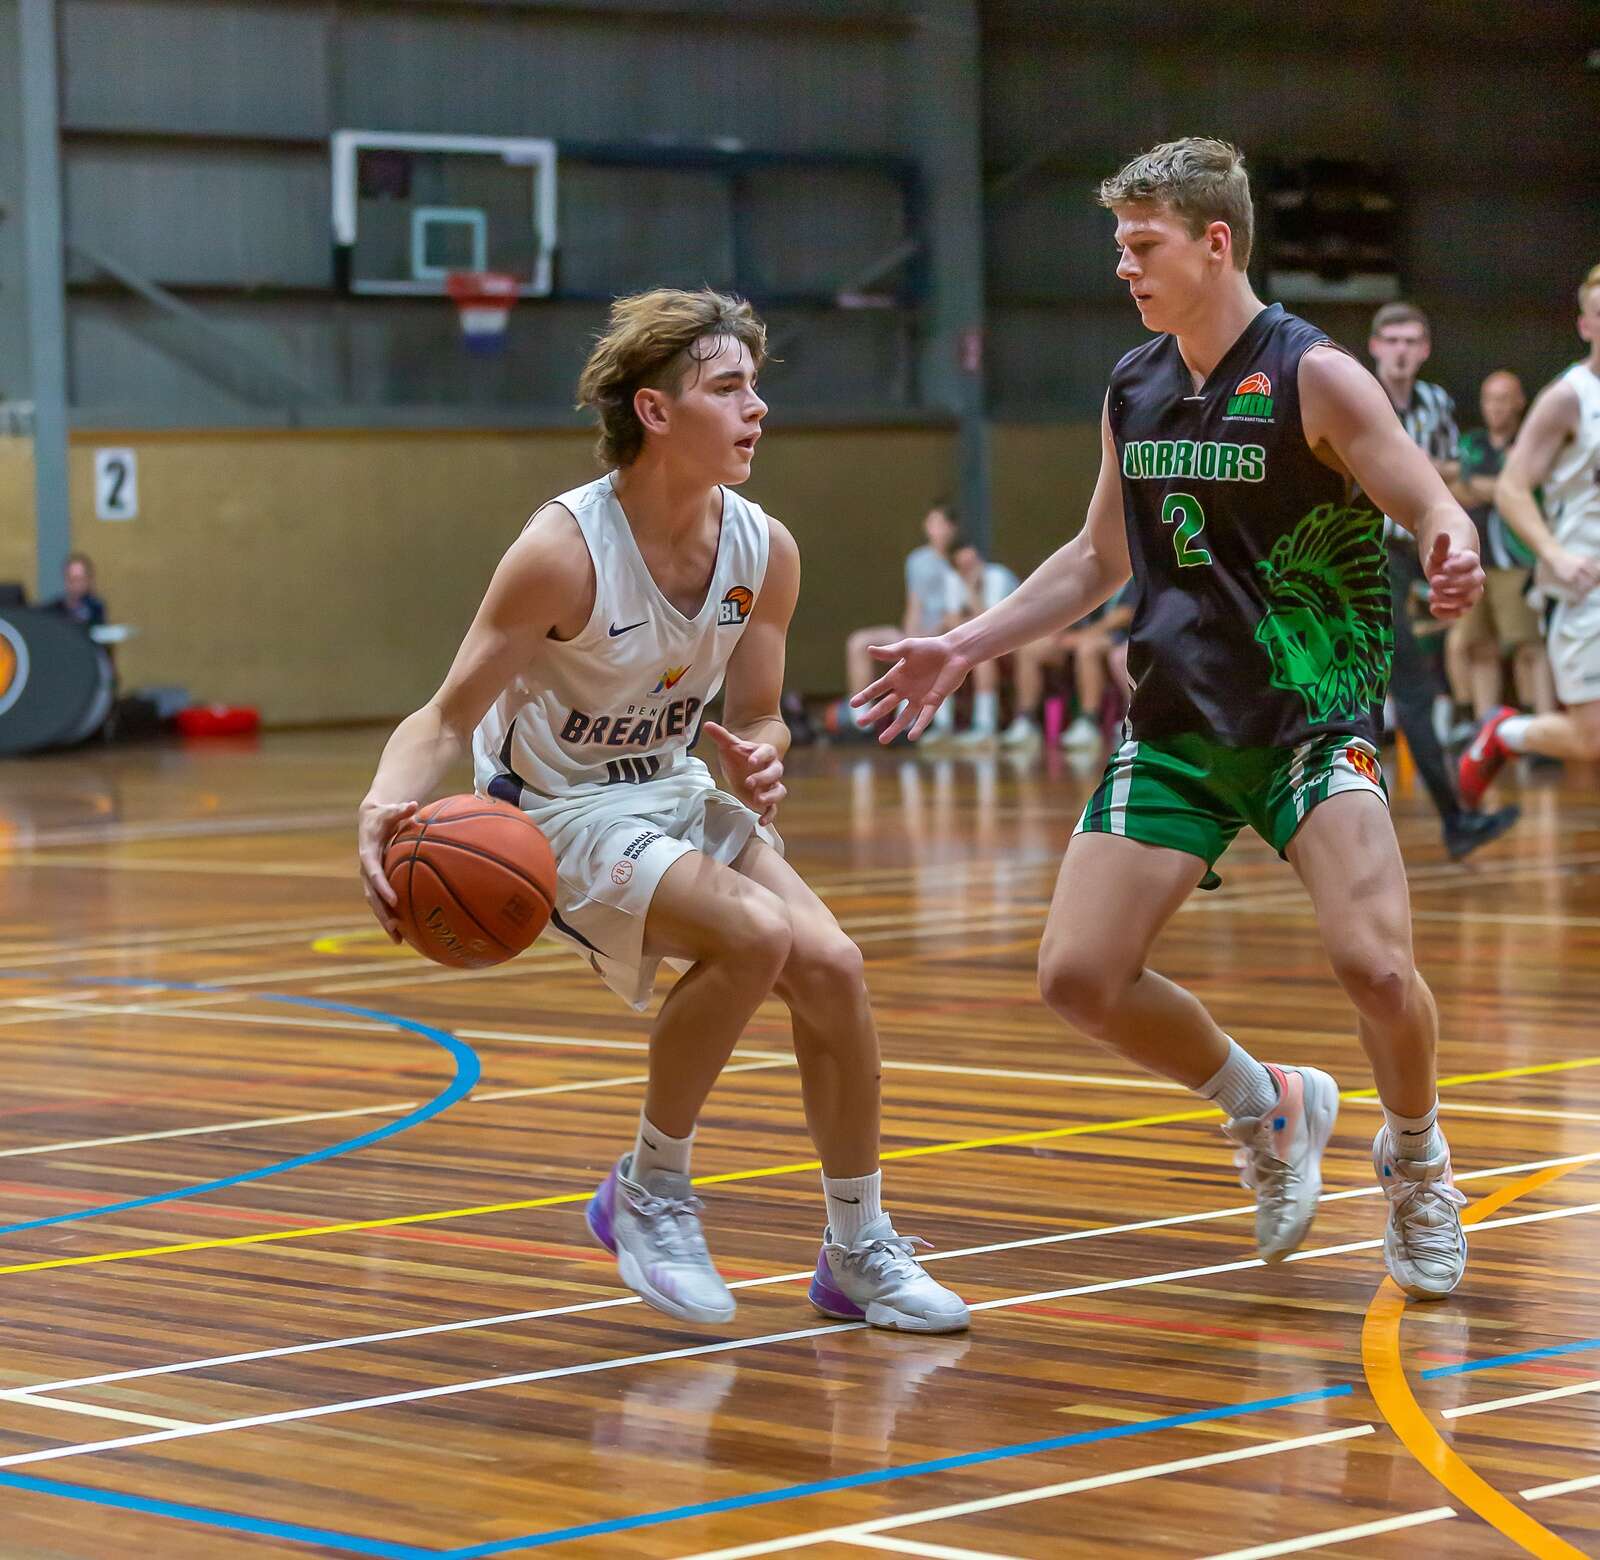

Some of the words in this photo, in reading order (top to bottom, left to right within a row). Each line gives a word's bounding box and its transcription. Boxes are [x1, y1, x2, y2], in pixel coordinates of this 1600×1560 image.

[1123, 439, 1266, 483] WARRIORS
[104, 461, 126, 510] 2
[1161, 492, 1213, 568] 2
[719, 600, 743, 622] BL
[623, 831, 654, 857] BENALLA
